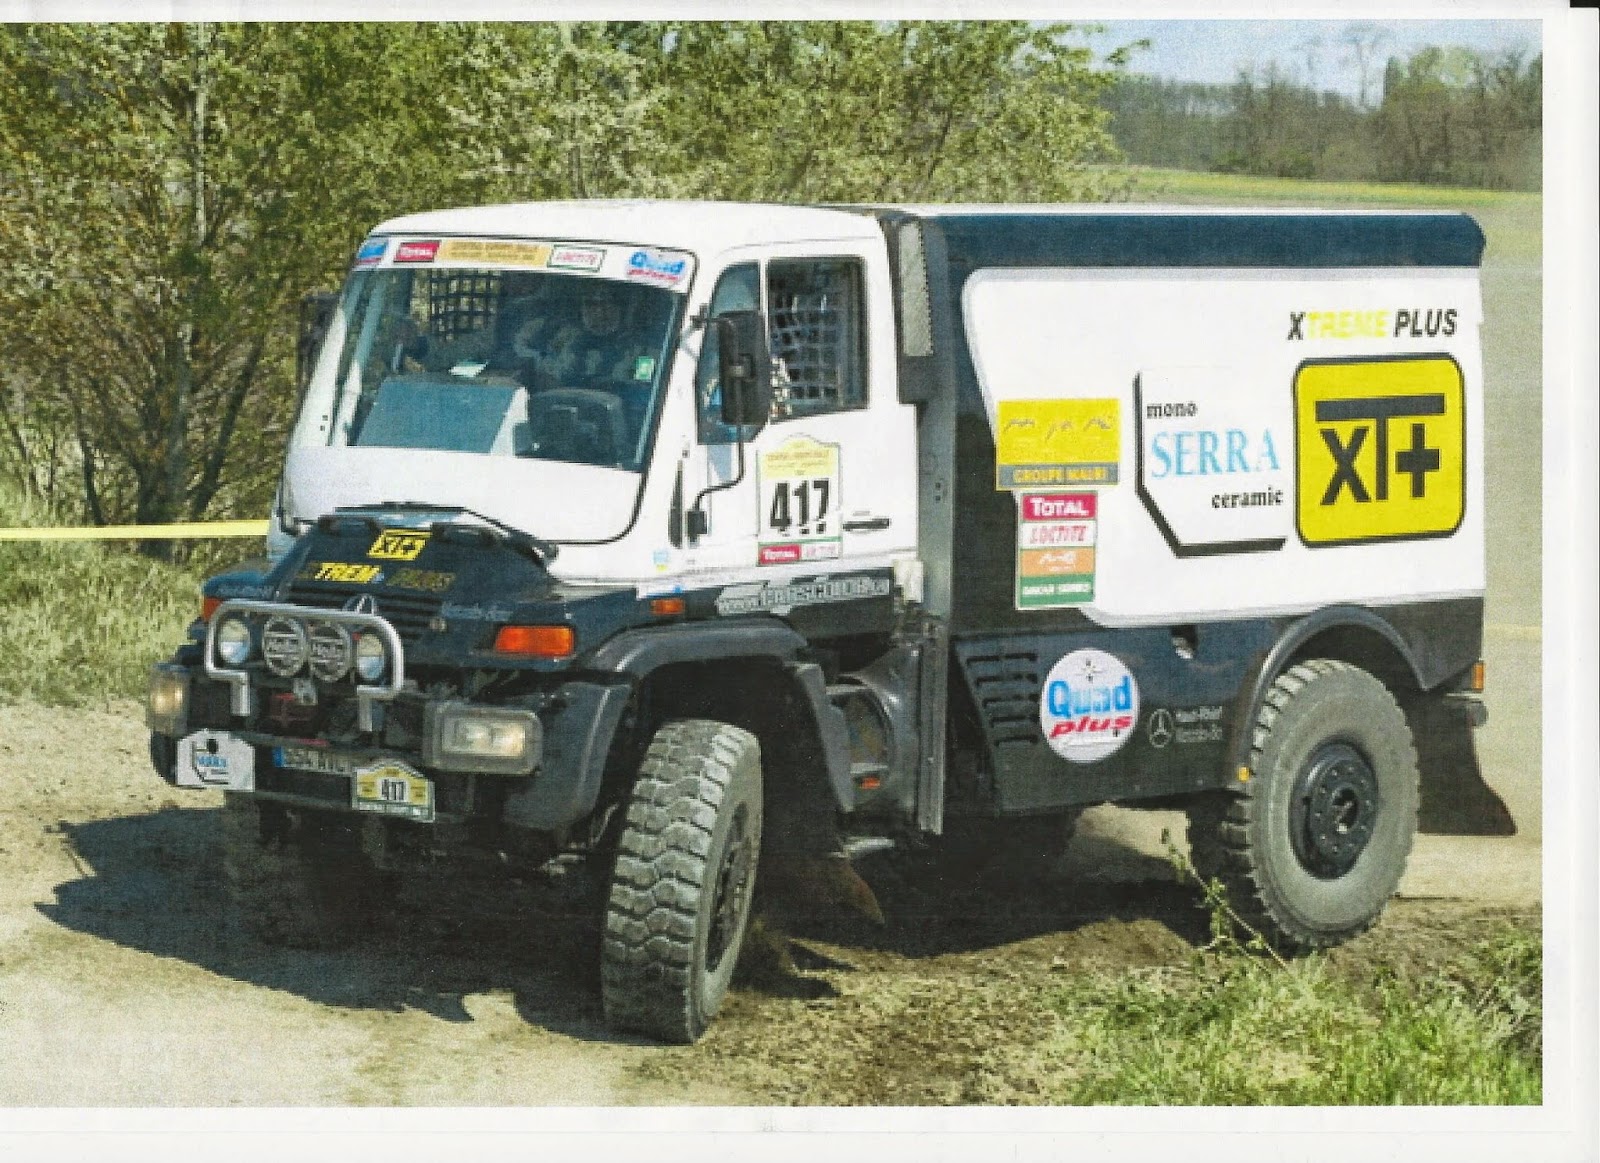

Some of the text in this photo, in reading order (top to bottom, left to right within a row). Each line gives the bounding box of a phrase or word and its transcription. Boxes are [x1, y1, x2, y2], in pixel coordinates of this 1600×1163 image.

[1287, 308, 1459, 341] XTREME PLUS
[1146, 401, 1199, 419] mono
[1150, 427, 1281, 480] SERRA
[769, 477, 830, 536] 417
[1029, 496, 1090, 518] TOTAL
[1210, 486, 1284, 509] ceramic
[1047, 674, 1134, 720] Quad
[1048, 715, 1134, 740] plus
